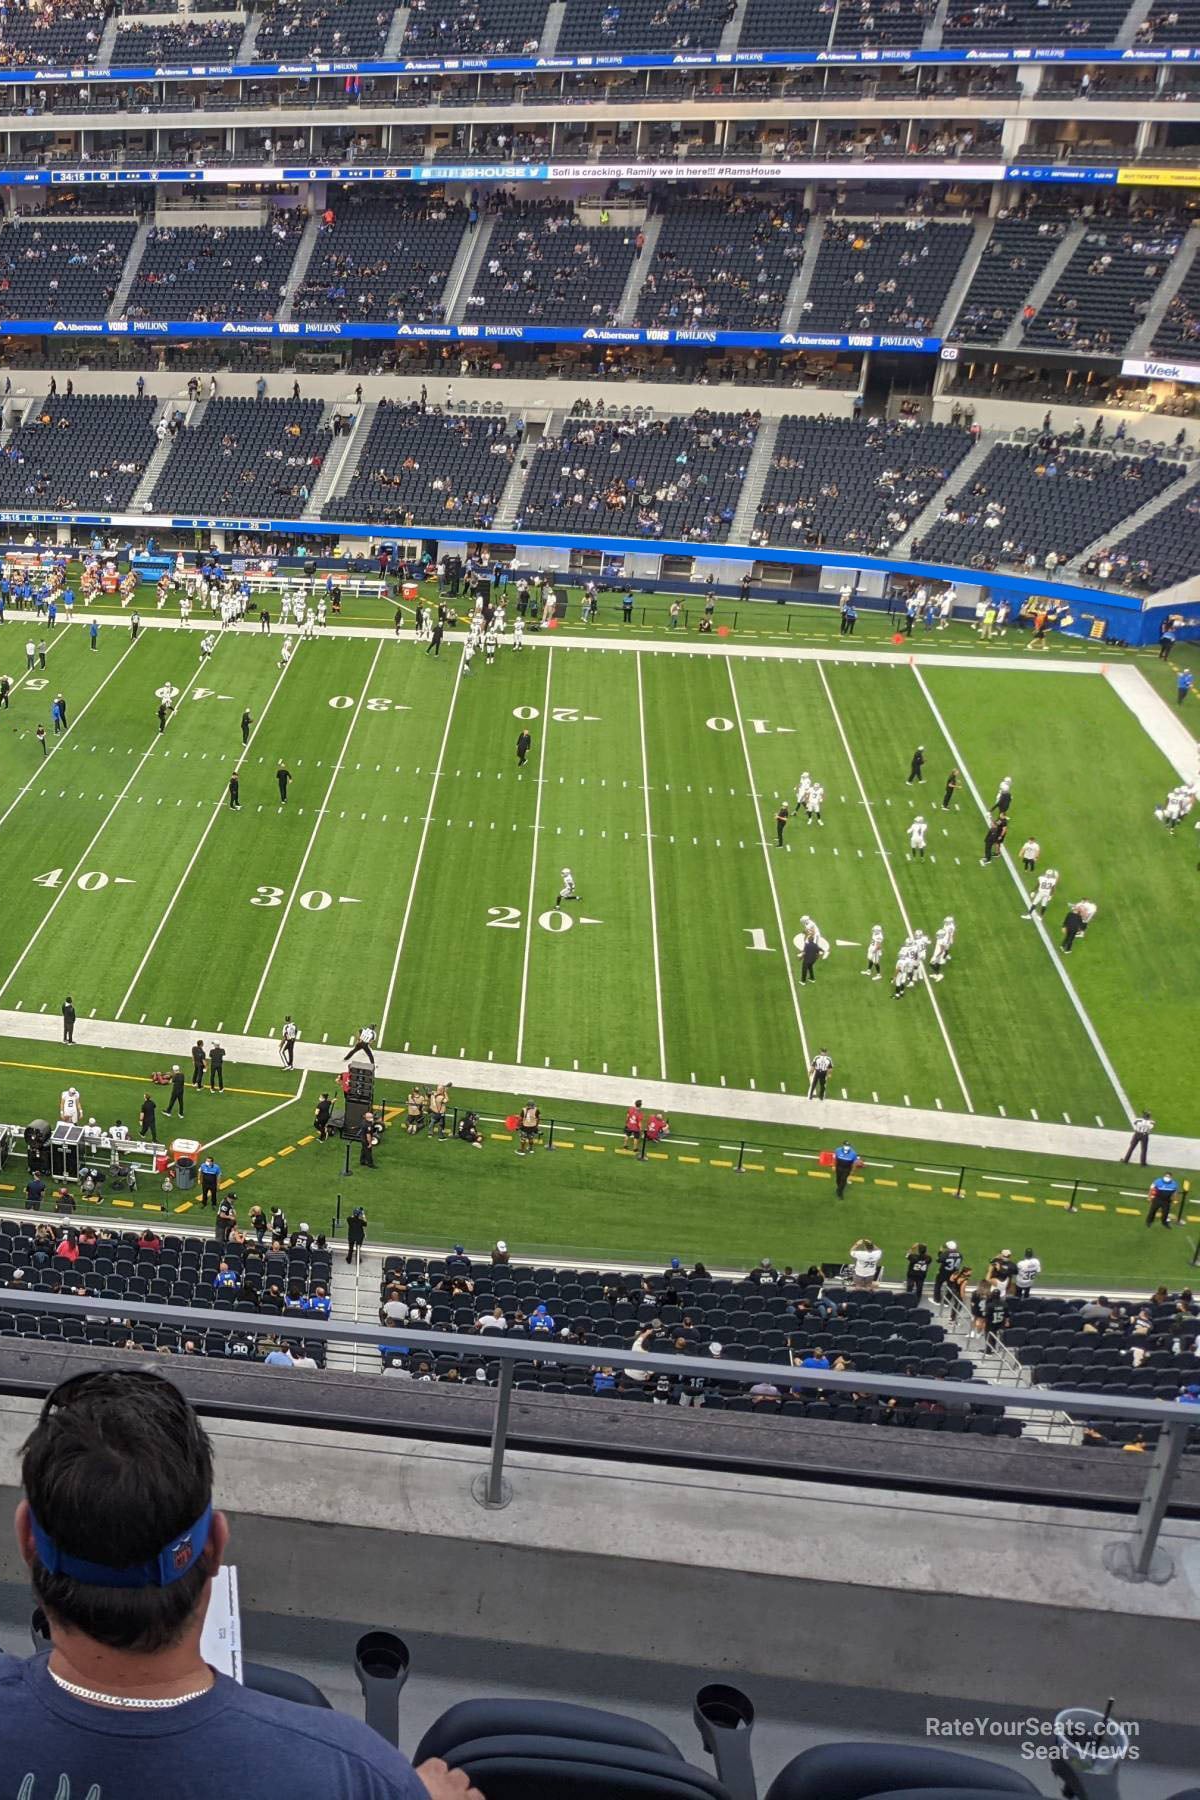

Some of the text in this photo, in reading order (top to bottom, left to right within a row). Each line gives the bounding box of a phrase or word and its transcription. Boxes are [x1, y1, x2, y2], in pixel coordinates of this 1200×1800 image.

[718, 168, 781, 176] #RamsHouse
[60, 173, 85, 181] 34:15
[108, 322, 128, 330] VONS
[235, 325, 273, 333] Albertsons
[279, 324, 299, 332] VONS
[411, 327, 451, 336] Albertsons
[457, 326, 479, 335] VONS
[599, 331, 640, 340] Albertsons
[646, 331, 669, 340] VONS
[796, 337, 841, 346] Albertsons
[848, 336, 873, 346] VONS
[942, 350, 957, 359] CC
[1143, 363, 1180, 377] Week
[32, 868, 109, 891] 40
[250, 886, 332, 910] 30
[486, 906, 573, 932] 20
[68, 1100, 74, 1108] 2
[913, 1264, 927, 1272] 24
[993, 1312, 1004, 1323] 15
